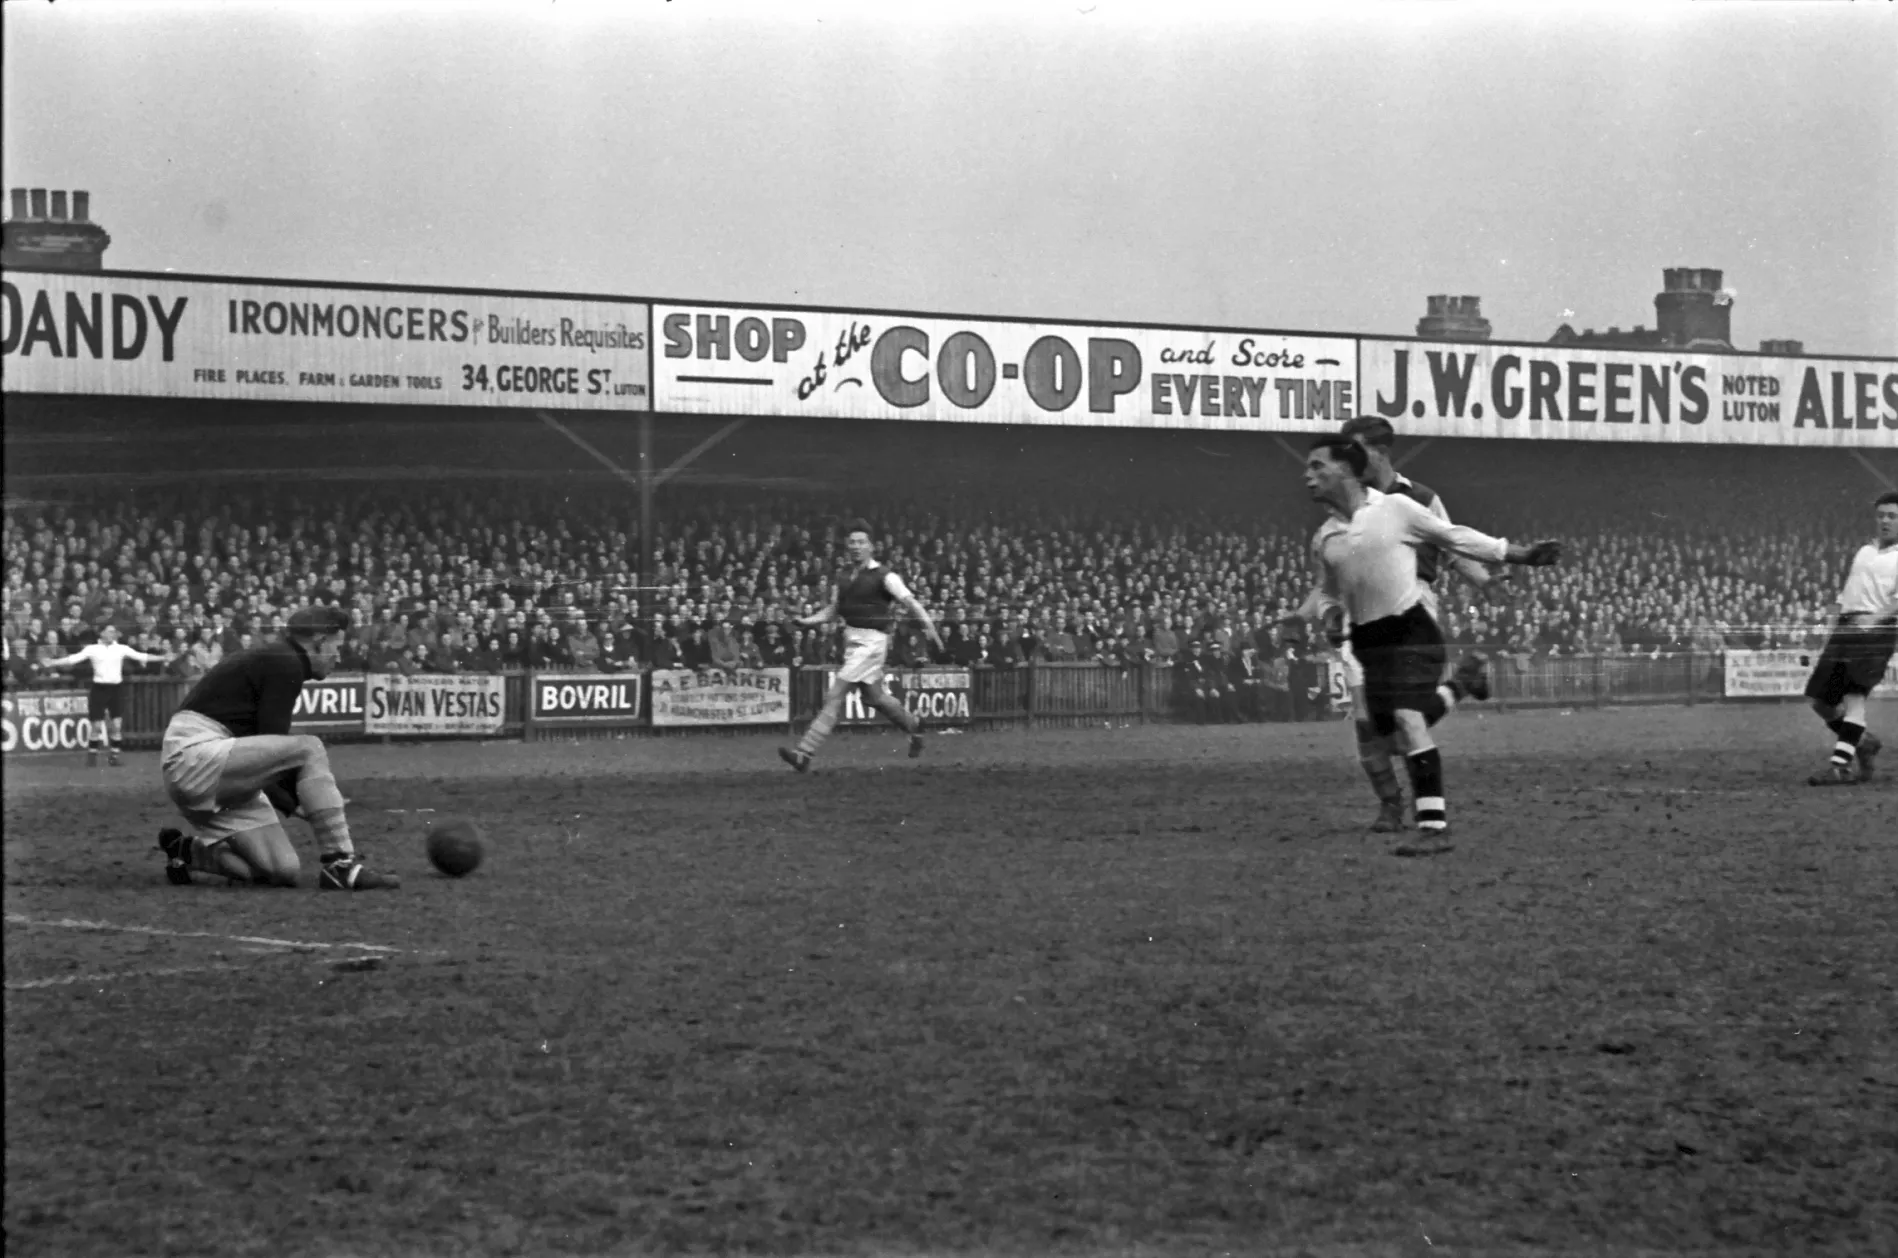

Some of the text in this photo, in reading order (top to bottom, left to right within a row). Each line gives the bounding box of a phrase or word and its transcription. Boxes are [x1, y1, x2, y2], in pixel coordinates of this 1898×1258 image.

[228, 299, 469, 343] IRONMONGERS
[488, 314, 556, 346] Builders
[560, 317, 645, 354] Requisites
[663, 312, 1142, 413] SHOP at the CO-OP
[1160, 338, 1304, 369] and Score
[194, 369, 226, 383] FIRE
[299, 371, 335, 386] FARM
[349, 373, 399, 388] GARDEN
[406, 375, 442, 390] TOOLS
[496, 364, 579, 394] GEORGE
[614, 383, 646, 396] LUTON
[1722, 374, 1780, 397] NOTED
[1151, 373, 1352, 421] EVERY TIME
[1722, 400, 1780, 422] LUTON
[293, 688, 363, 715] VRIL
[371, 686, 500, 719] SWAN VESTAS
[541, 684, 631, 710] BOVRIL
[904, 690, 970, 717] COCOA
